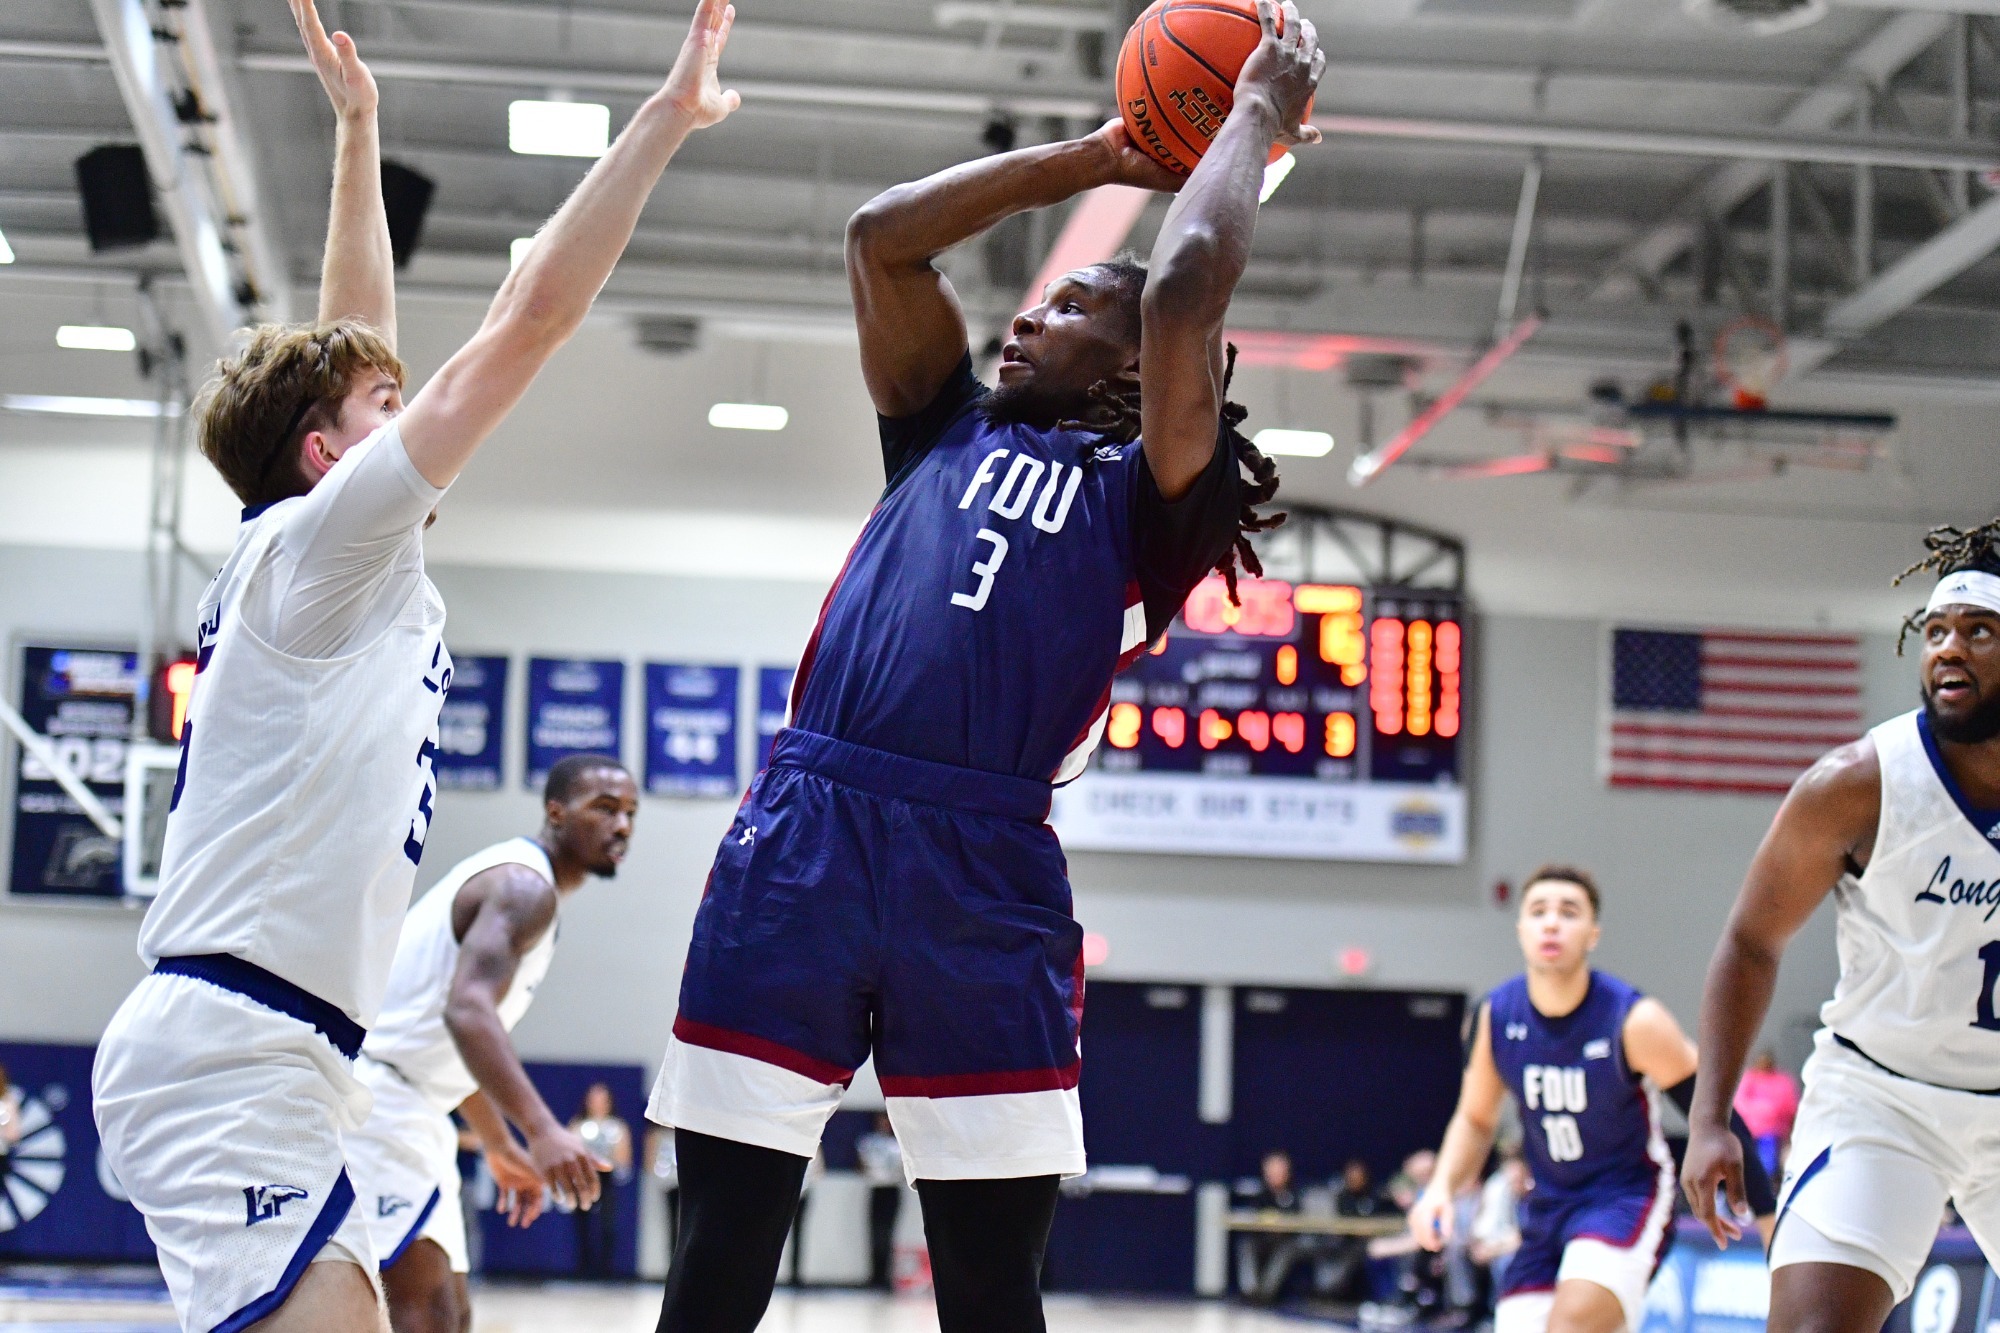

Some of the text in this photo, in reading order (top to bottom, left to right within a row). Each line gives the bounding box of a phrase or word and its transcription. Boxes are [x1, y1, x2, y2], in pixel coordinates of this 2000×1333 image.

[1168, 89, 1218, 142] ACY
[957, 448, 1084, 534] FDU
[950, 528, 1009, 612] 3
[1087, 787, 1178, 817] CHECK
[1523, 1064, 1588, 1114] FDU
[1541, 1113, 1584, 1163] 10
